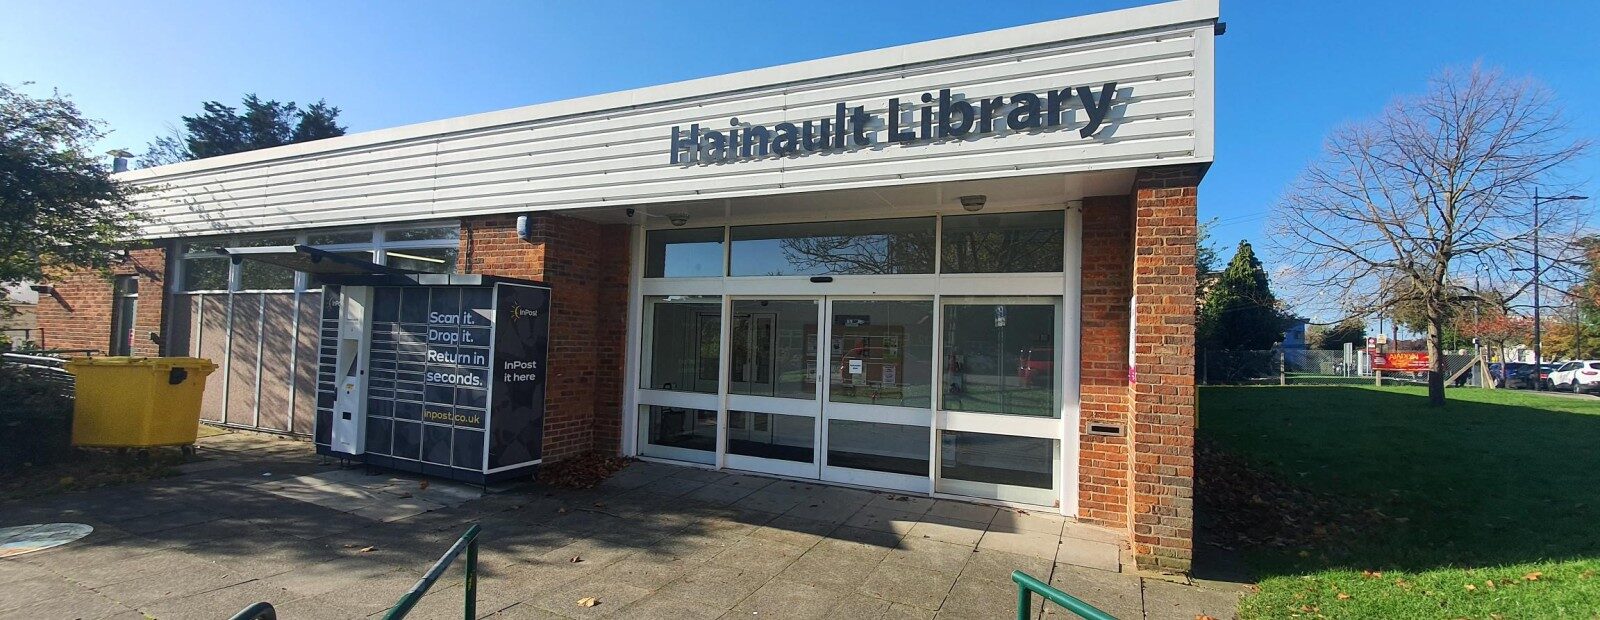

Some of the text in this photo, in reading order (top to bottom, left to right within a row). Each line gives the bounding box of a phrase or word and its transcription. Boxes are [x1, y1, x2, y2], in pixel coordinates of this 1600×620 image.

[670, 82, 1117, 165] Hainault Library
[430, 312, 474, 324] Scan it.
[429, 329, 474, 344] Drop it.
[428, 350, 484, 364] Return in
[504, 360, 536, 370] InPost
[426, 372, 482, 386] seconds.
[504, 373, 536, 382] it here
[424, 408, 480, 423] inpost.co.uk
